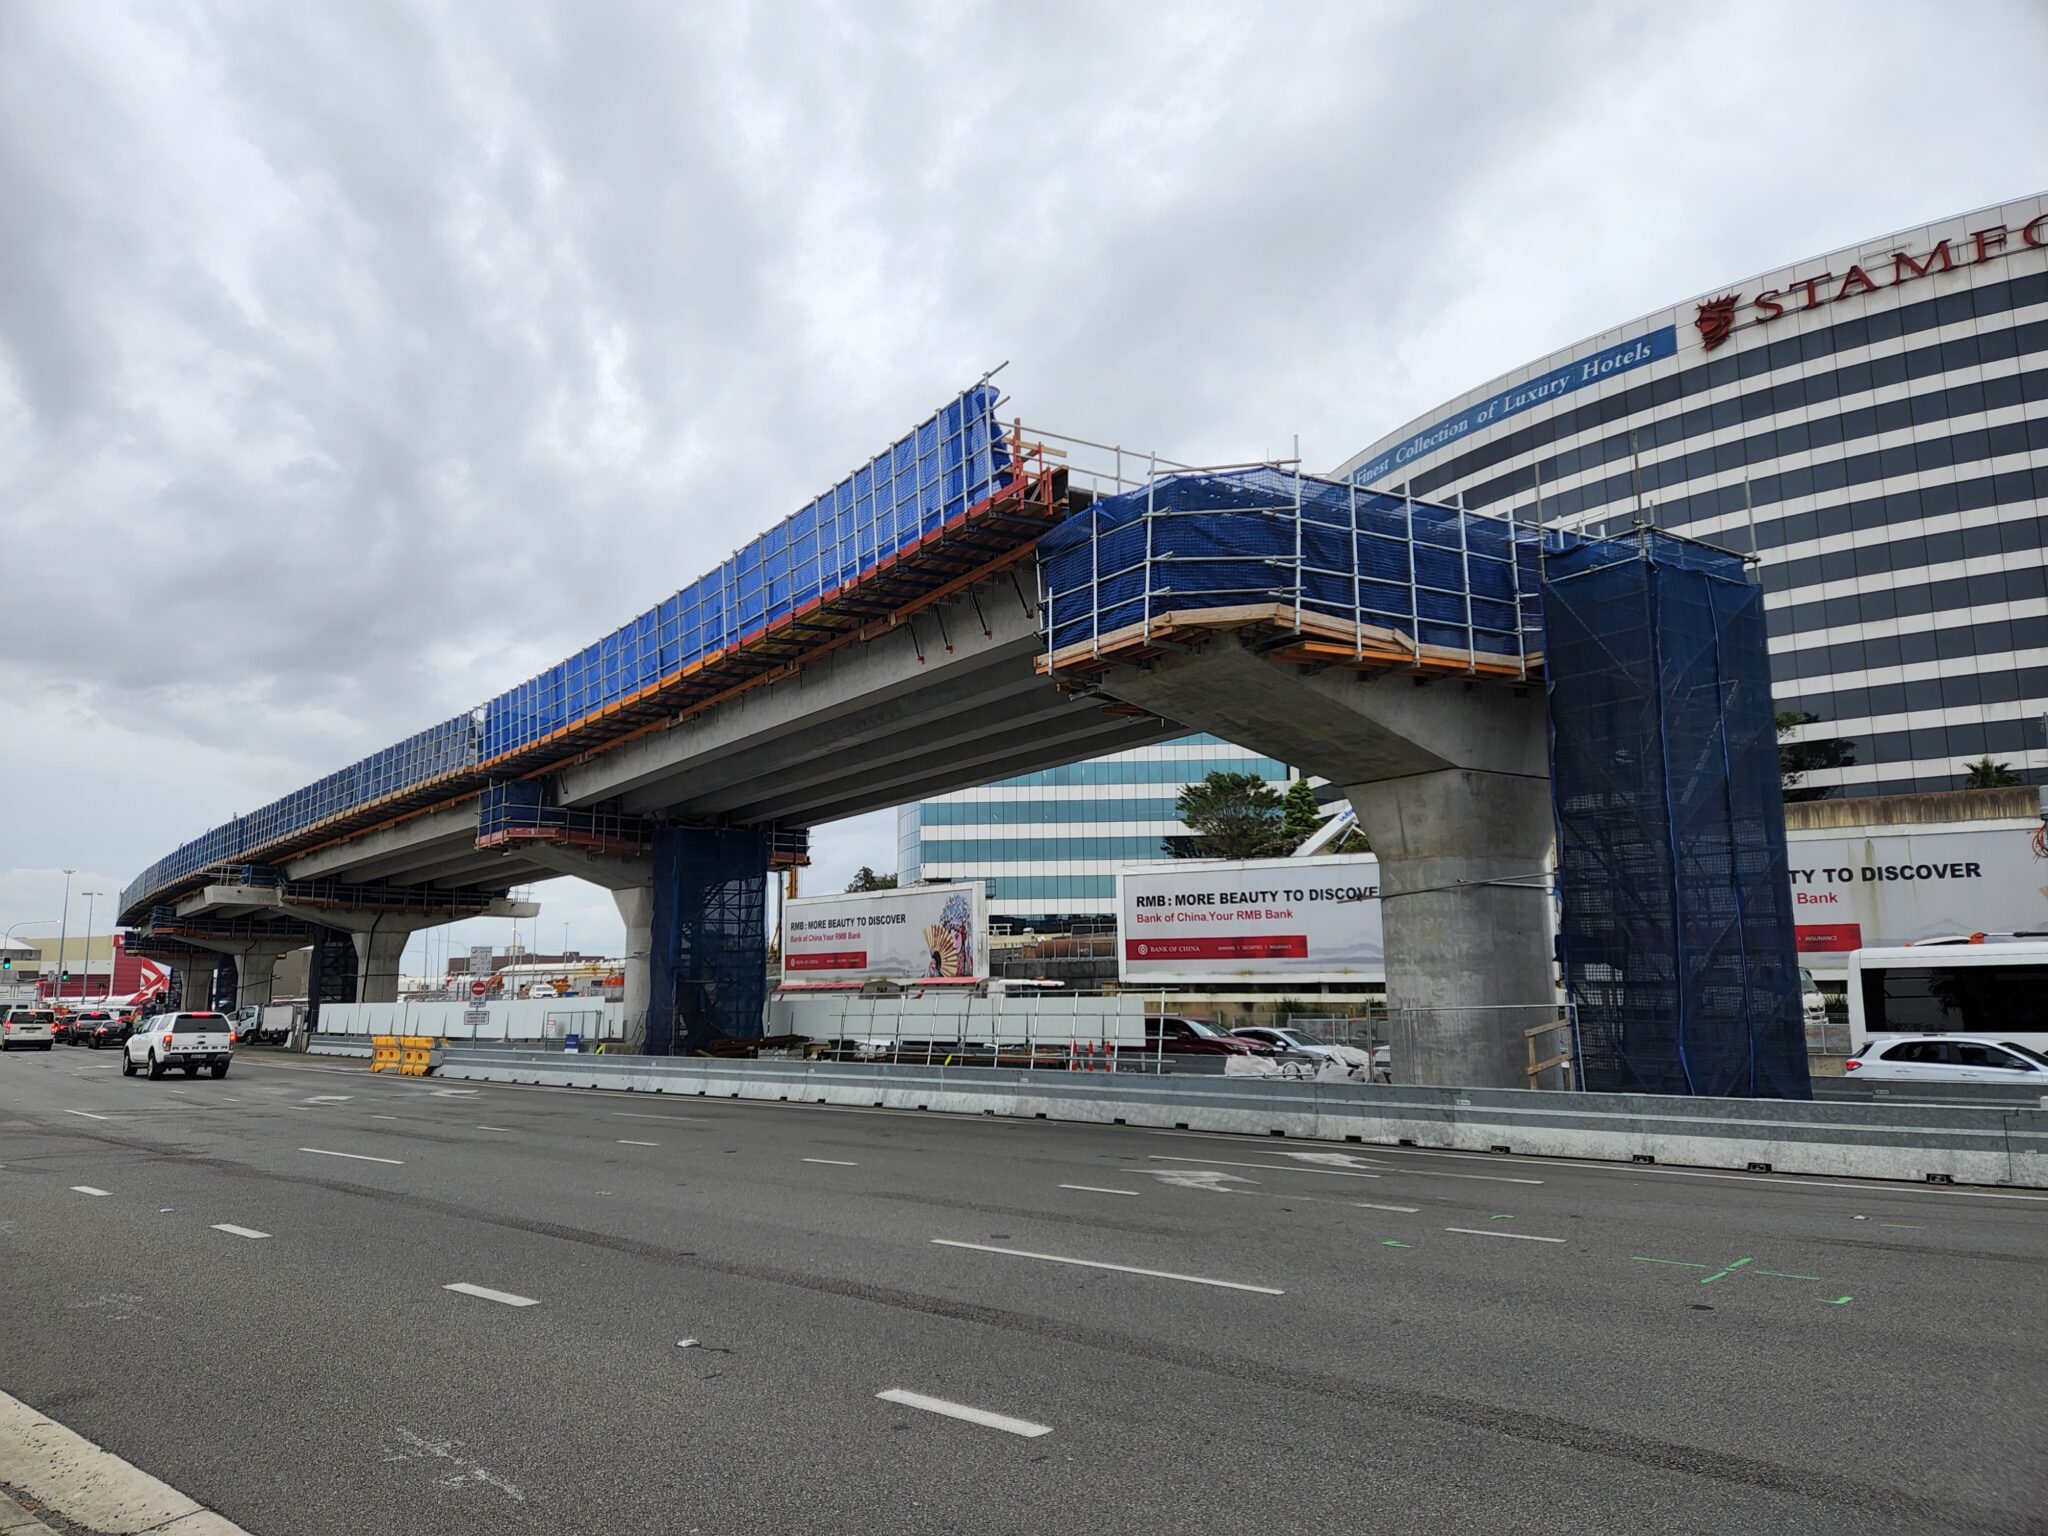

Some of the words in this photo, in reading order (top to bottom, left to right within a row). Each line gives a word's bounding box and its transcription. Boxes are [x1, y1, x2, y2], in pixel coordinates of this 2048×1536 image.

[1356, 458, 1390, 487] Finest
[1396, 418, 1469, 464] Collection
[1477, 400, 1498, 424] of
[1503, 374, 1571, 413] Luxury
[1580, 342, 1652, 382] Hotels
[1823, 868, 1853, 883] TO
[1862, 862, 1982, 882] DISCOVER
[1175, 894, 1215, 906] MORE
[1220, 890, 1279, 904] BEAUTY
[1286, 890, 1304, 902] TO
[1797, 892, 1838, 904] Bank
[808, 920, 826, 930] MORE
[828, 918, 855, 929] BEAUTY
[857, 917, 866, 926] TO
[868, 914, 906, 926] DISCOVER
[1136, 913, 1161, 923] Bank
[1164, 912, 1175, 922] of
[1236, 910, 1262, 921] RMB
[1266, 909, 1293, 920] Bank
[790, 935, 802, 943] Bank
[803, 934, 808, 942] of
[848, 932, 861, 940] Bank
